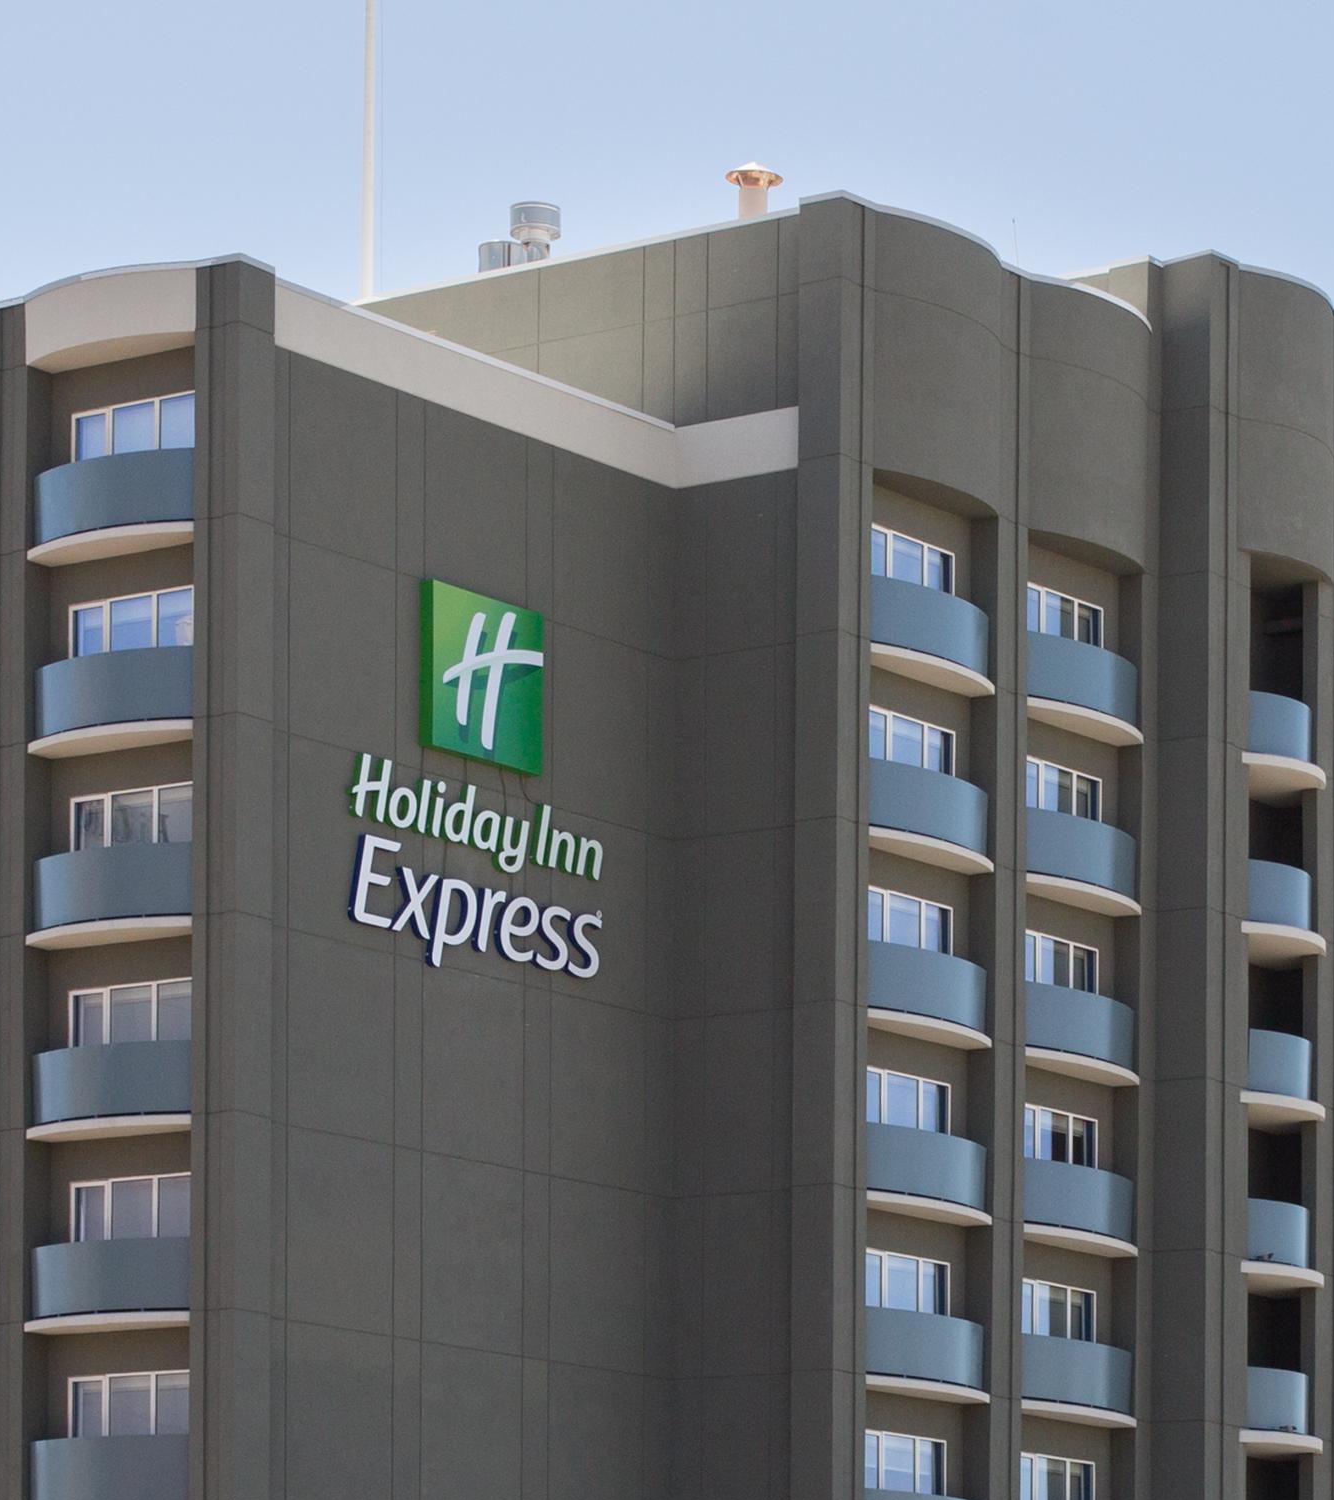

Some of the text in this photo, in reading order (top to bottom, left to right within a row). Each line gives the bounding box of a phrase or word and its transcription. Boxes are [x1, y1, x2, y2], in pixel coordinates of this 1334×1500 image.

[350, 753, 604, 881] Holiday Inn
[351, 833, 603, 979] Express
